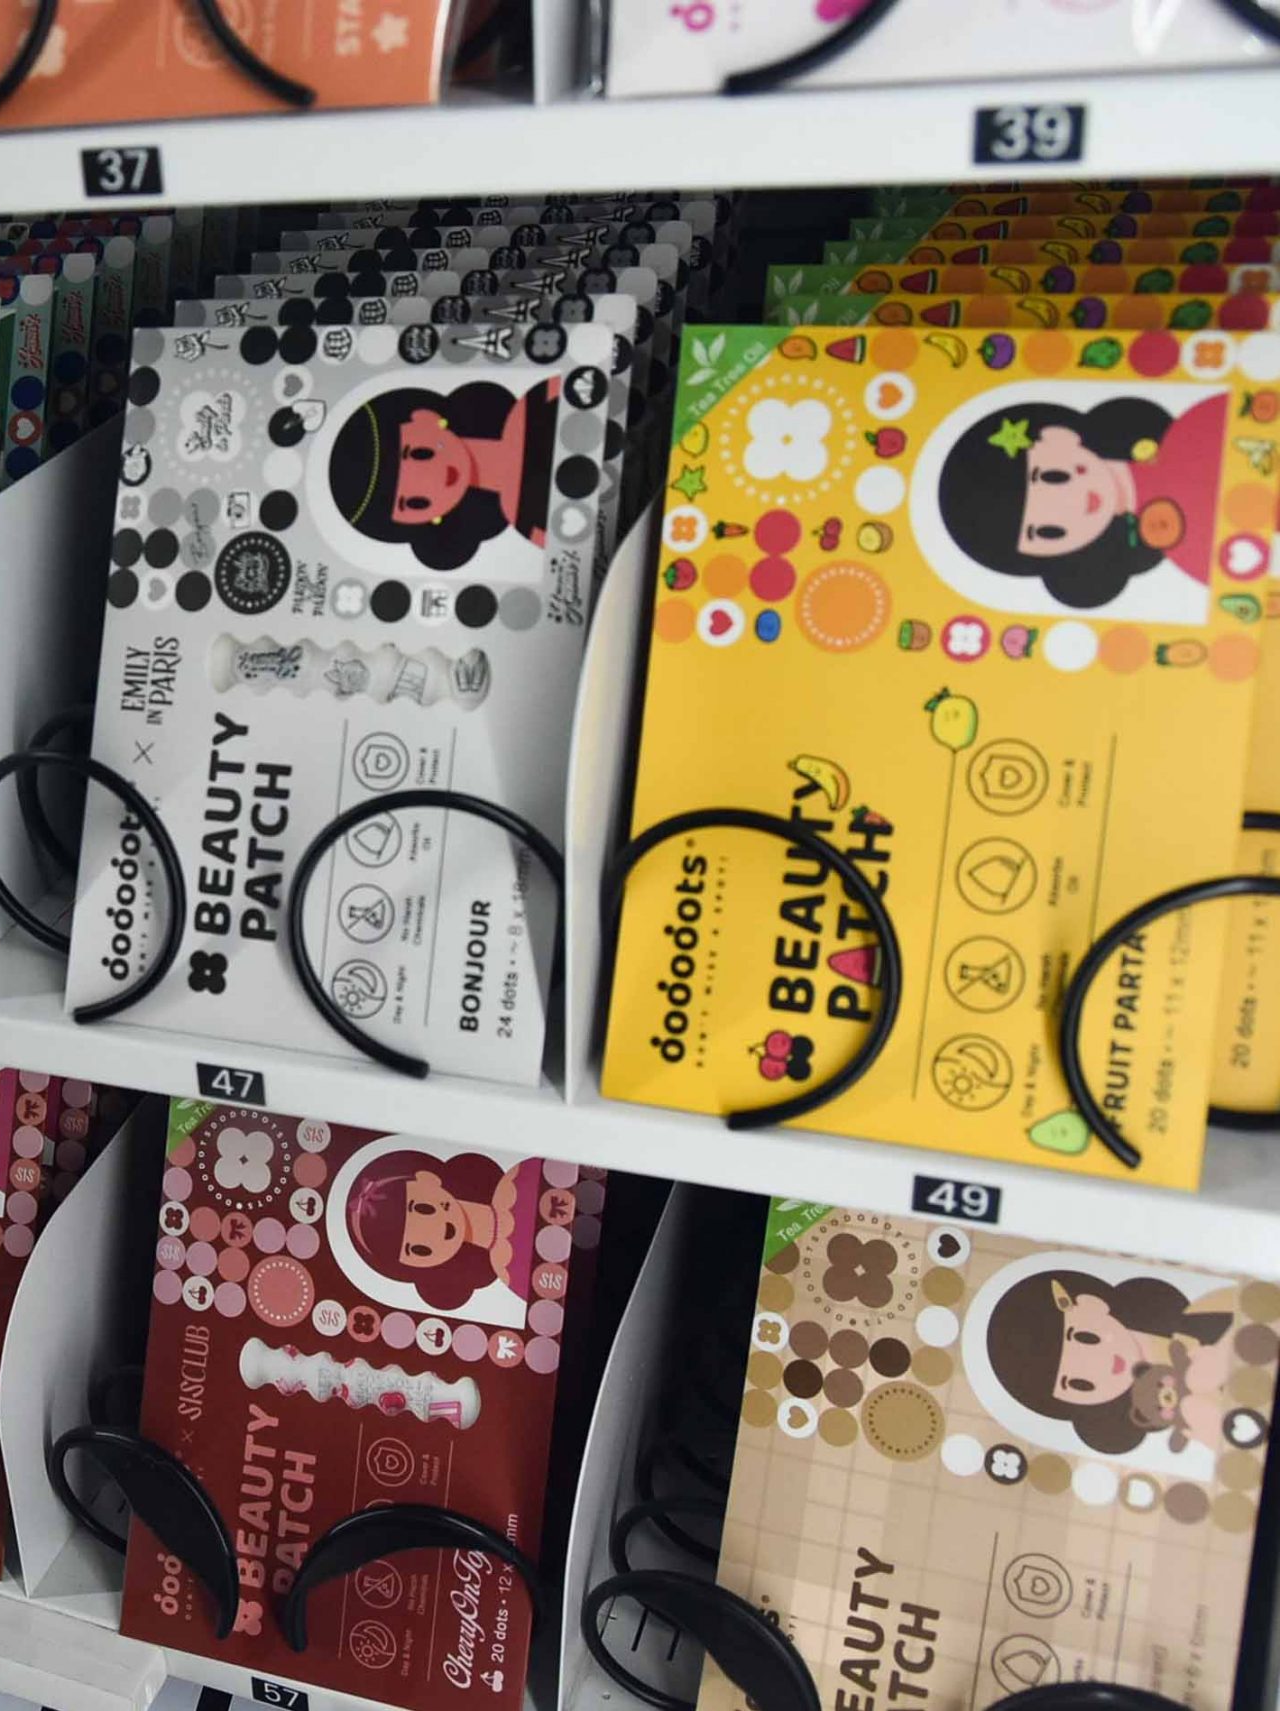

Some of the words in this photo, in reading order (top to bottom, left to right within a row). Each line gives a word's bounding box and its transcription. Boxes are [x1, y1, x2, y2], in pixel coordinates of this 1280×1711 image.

[991, 105, 1073, 161] 39
[99, 150, 150, 191] 37
[120, 646, 150, 712] EMILY
[147, 635, 181, 707] PARIS
[146, 708, 163, 725] IN
[194, 711, 248, 936] BEAUTY
[240, 762, 293, 942] PATCH
[459, 899, 491, 1033] BONJOUR
[650, 855, 707, 1064] dododots
[499, 971, 519, 1012] dots
[497, 1016, 513, 1039] 24
[210, 1070, 254, 1099] 47
[1151, 1058, 1175, 1104] dots
[304, 1126, 324, 1143] SIS
[15, 1167, 34, 1183] SIS
[926, 1182, 989, 1219] 49
[777, 1221, 803, 1242] Tea
[539, 1272, 562, 1292] SIS
[319, 1309, 341, 1328] SIS
[177, 1324, 210, 1421] SISCLUB
[237, 1404, 279, 1591] BEAUTY
[498, 1577, 513, 1593] 12
[494, 1608, 509, 1641] dots
[491, 1643, 506, 1665] 20
[263, 1682, 299, 1707] 57
